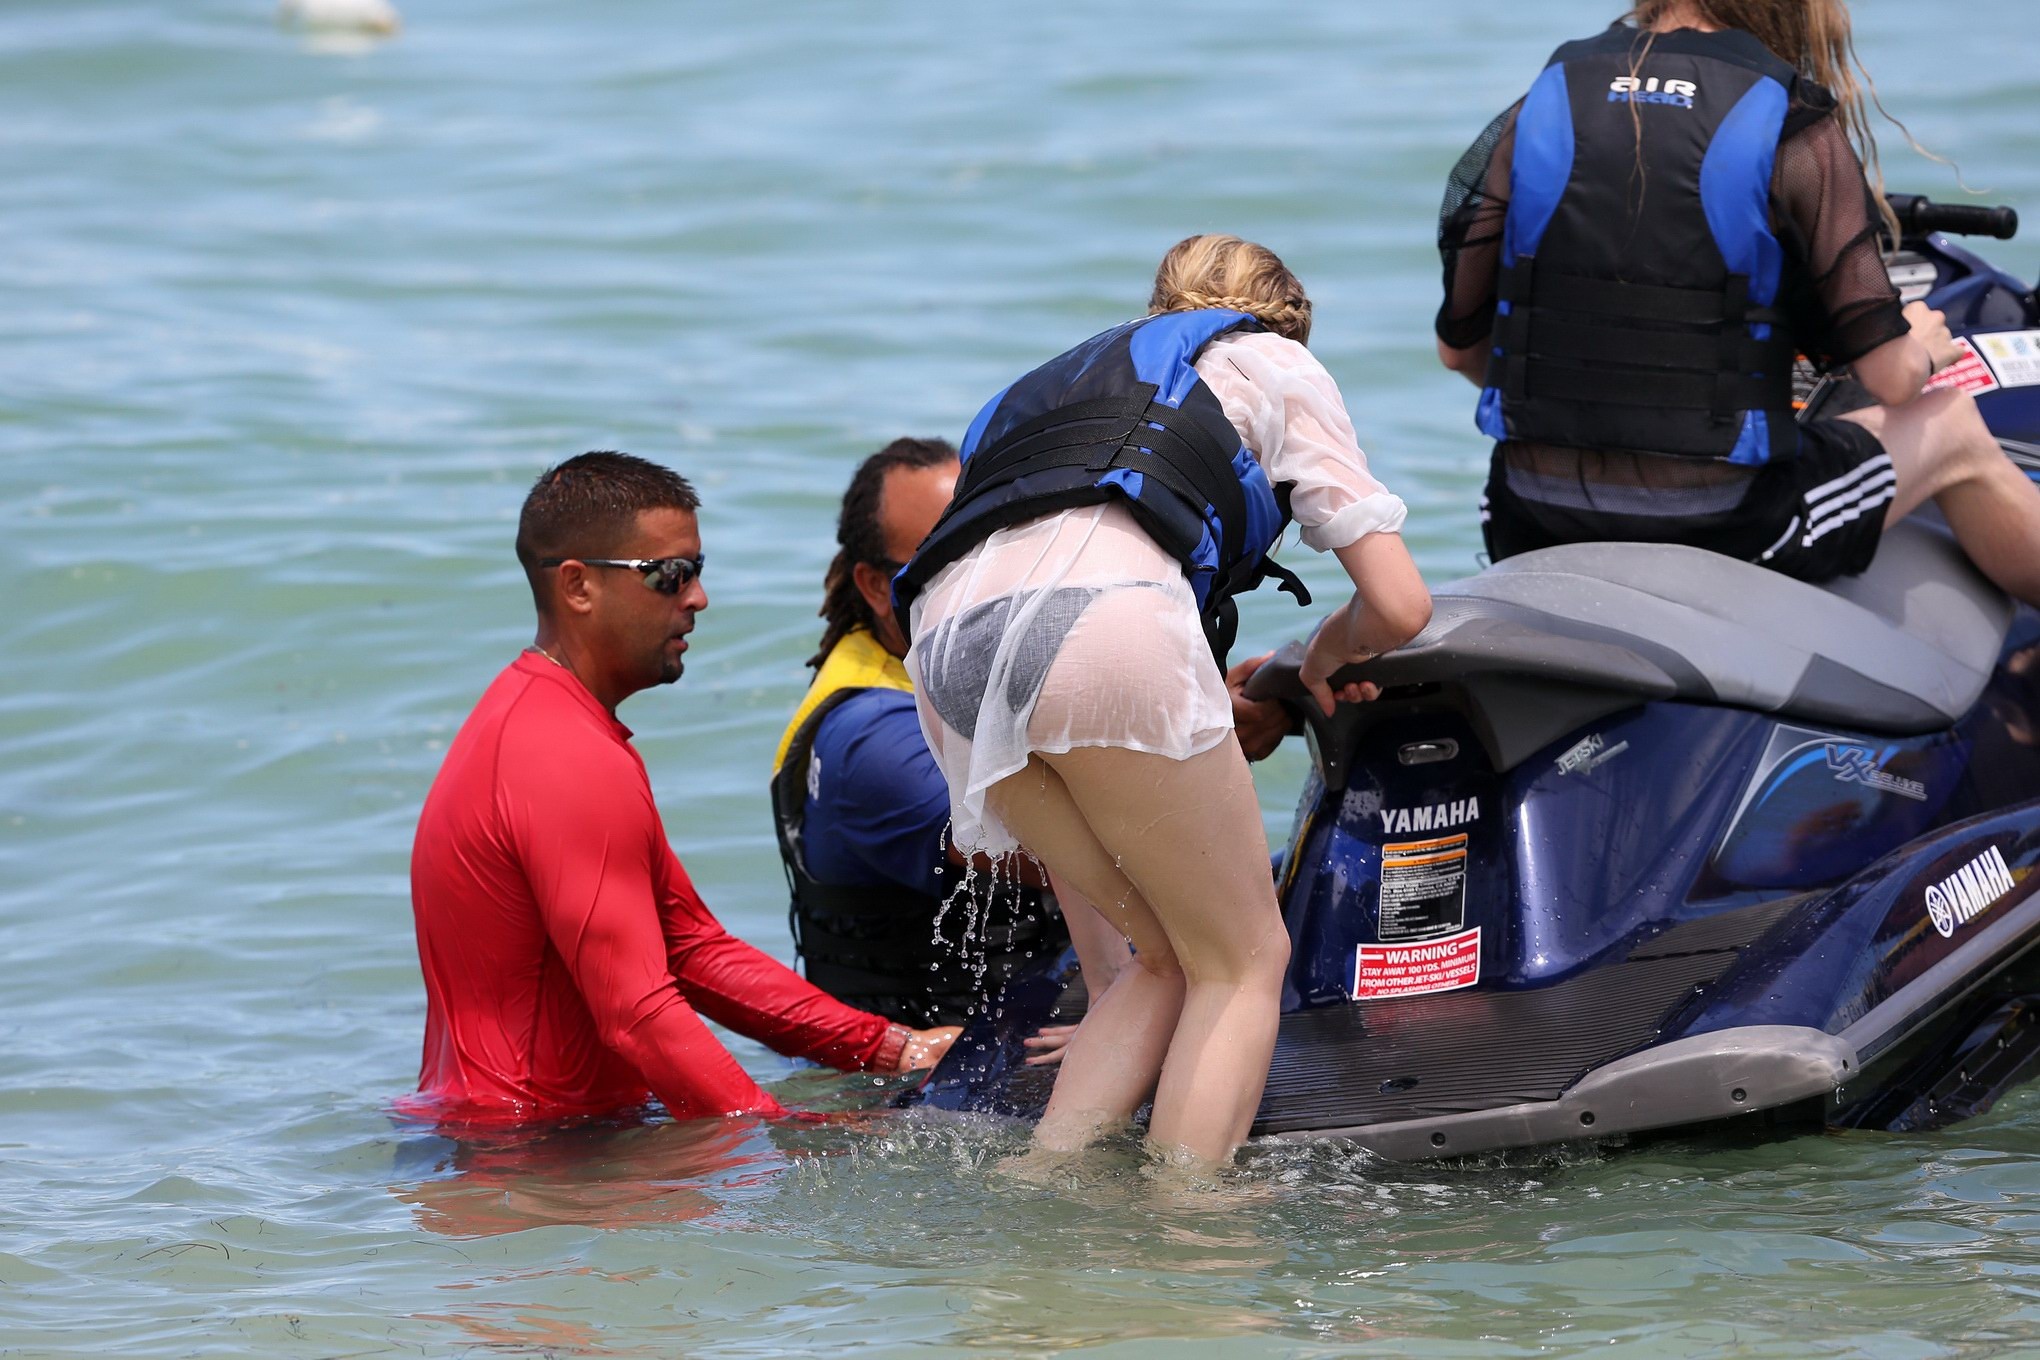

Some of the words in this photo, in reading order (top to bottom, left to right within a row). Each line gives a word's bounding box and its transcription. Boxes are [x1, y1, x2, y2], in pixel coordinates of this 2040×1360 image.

[1824, 743, 1877, 784] VX
[1380, 796, 1479, 834] YAMAHA
[1938, 844, 2016, 925] YAMAHA
[1361, 967, 1382, 977] STAY
[1382, 966, 1407, 976] AWAY
[1408, 964, 1422, 974] 100
[1422, 962, 1440, 973] YDS.
[1441, 952, 1476, 970] MINIMUM
[1385, 942, 1458, 965] WARNING
[1360, 978, 1386, 988] FROM
[1386, 975, 1414, 987] OTHER
[1445, 963, 1476, 979] VESSELS
[1376, 987, 1390, 996] NO
[1390, 984, 1432, 995] SPLASHING
[1431, 979, 1460, 990] OTHERS
